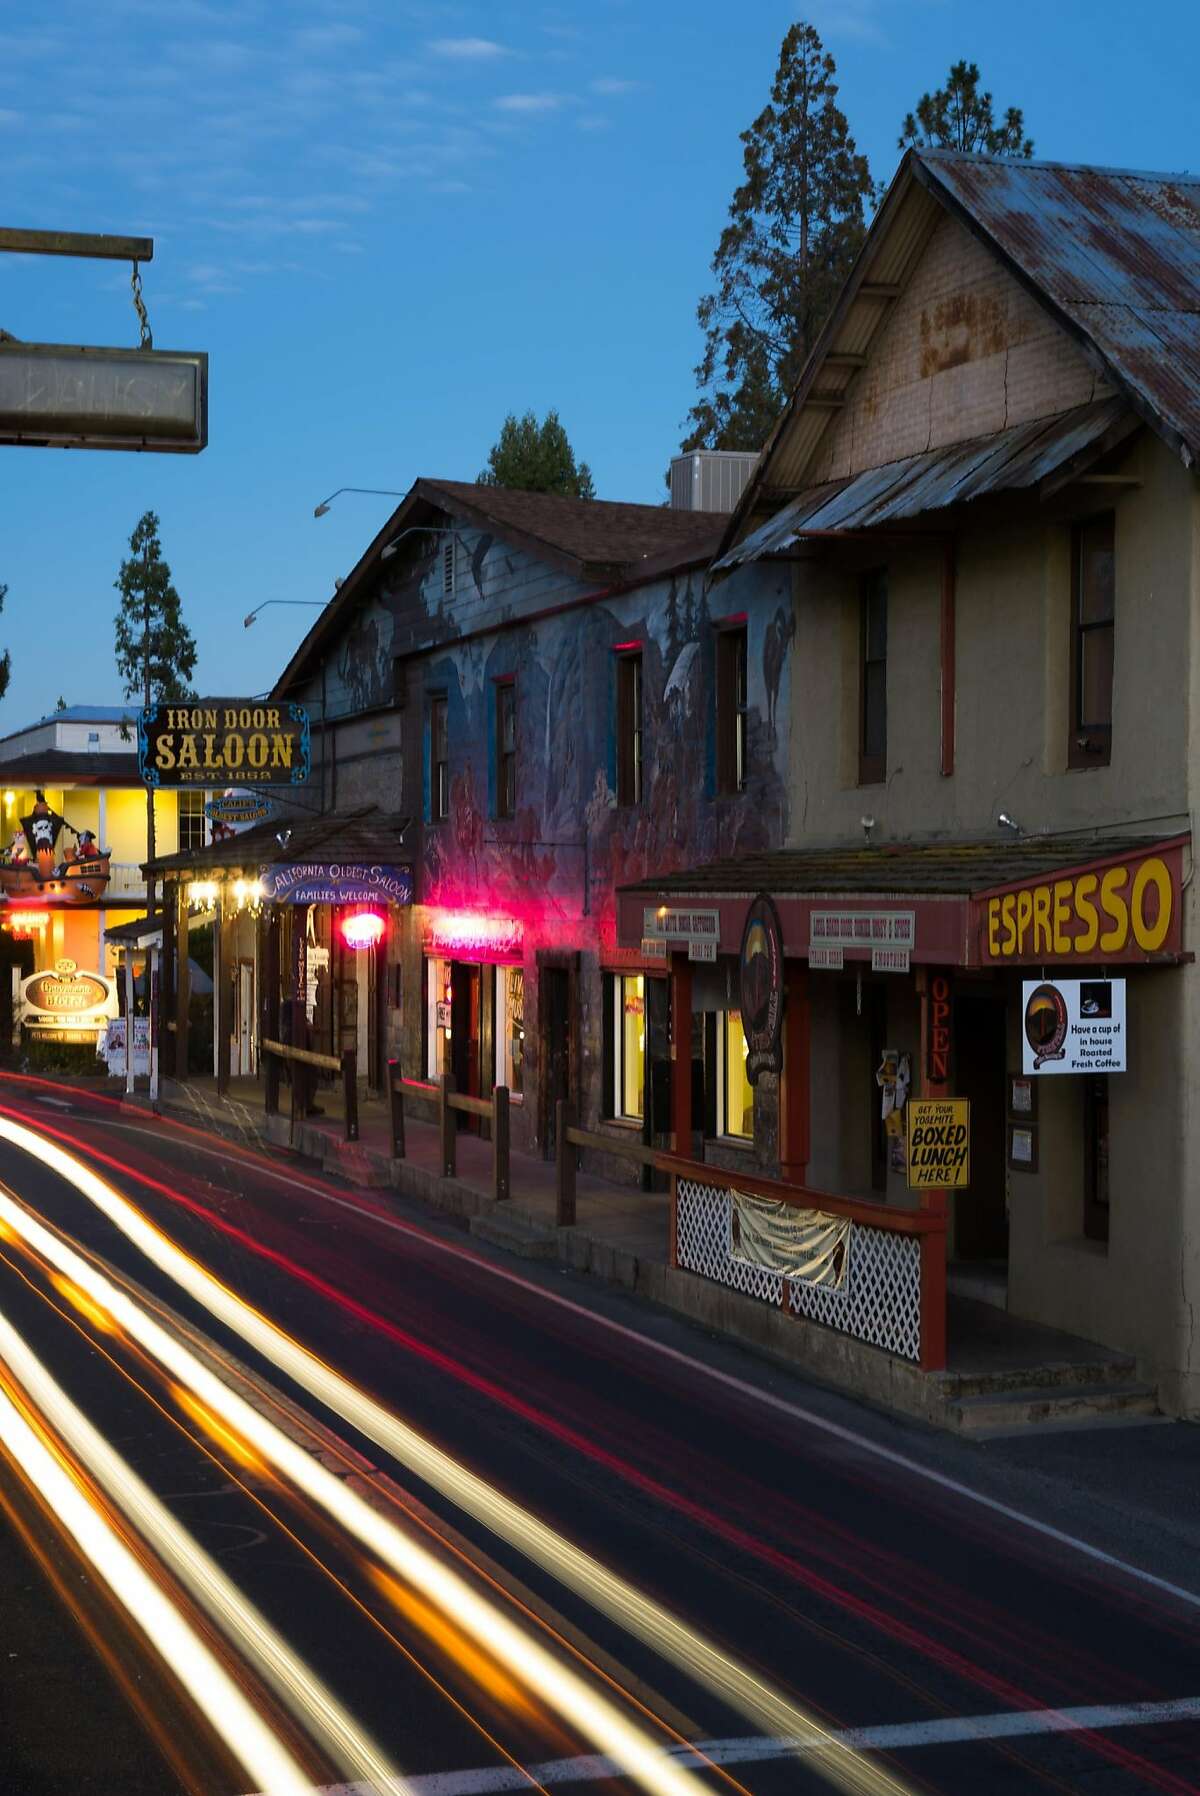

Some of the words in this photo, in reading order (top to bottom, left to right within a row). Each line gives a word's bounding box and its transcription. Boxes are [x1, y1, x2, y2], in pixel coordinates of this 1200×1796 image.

[166, 708, 216, 729] IRON
[223, 708, 280, 729] DOOR
[154, 732, 295, 769] SALOON
[259, 864, 325, 897] CALIFORNIA
[329, 863, 369, 879] OLDEST
[369, 865, 412, 901] SALOON
[295, 889, 336, 901] FAMILIES
[339, 889, 379, 902] WELCOME
[987, 856, 1173, 957] ESPRESSO
[931, 977, 950, 1077] OPEN
[1071, 1025, 1091, 1034] Have
[1099, 1026, 1112, 1035] cup
[1113, 1023, 1120, 1033] of
[1089, 1037, 1113, 1046] house
[1080, 1048, 1112, 1057] Roasted
[1071, 1060, 1093, 1068] Fresh
[1094, 1059, 1121, 1068] Coffee
[918, 1105, 932, 1114] GET
[936, 1105, 952, 1114] YOUR
[915, 1115, 953, 1125] YOSEMITE
[911, 1124, 967, 1147] BOXED
[910, 1147, 968, 1167] LUNCH
